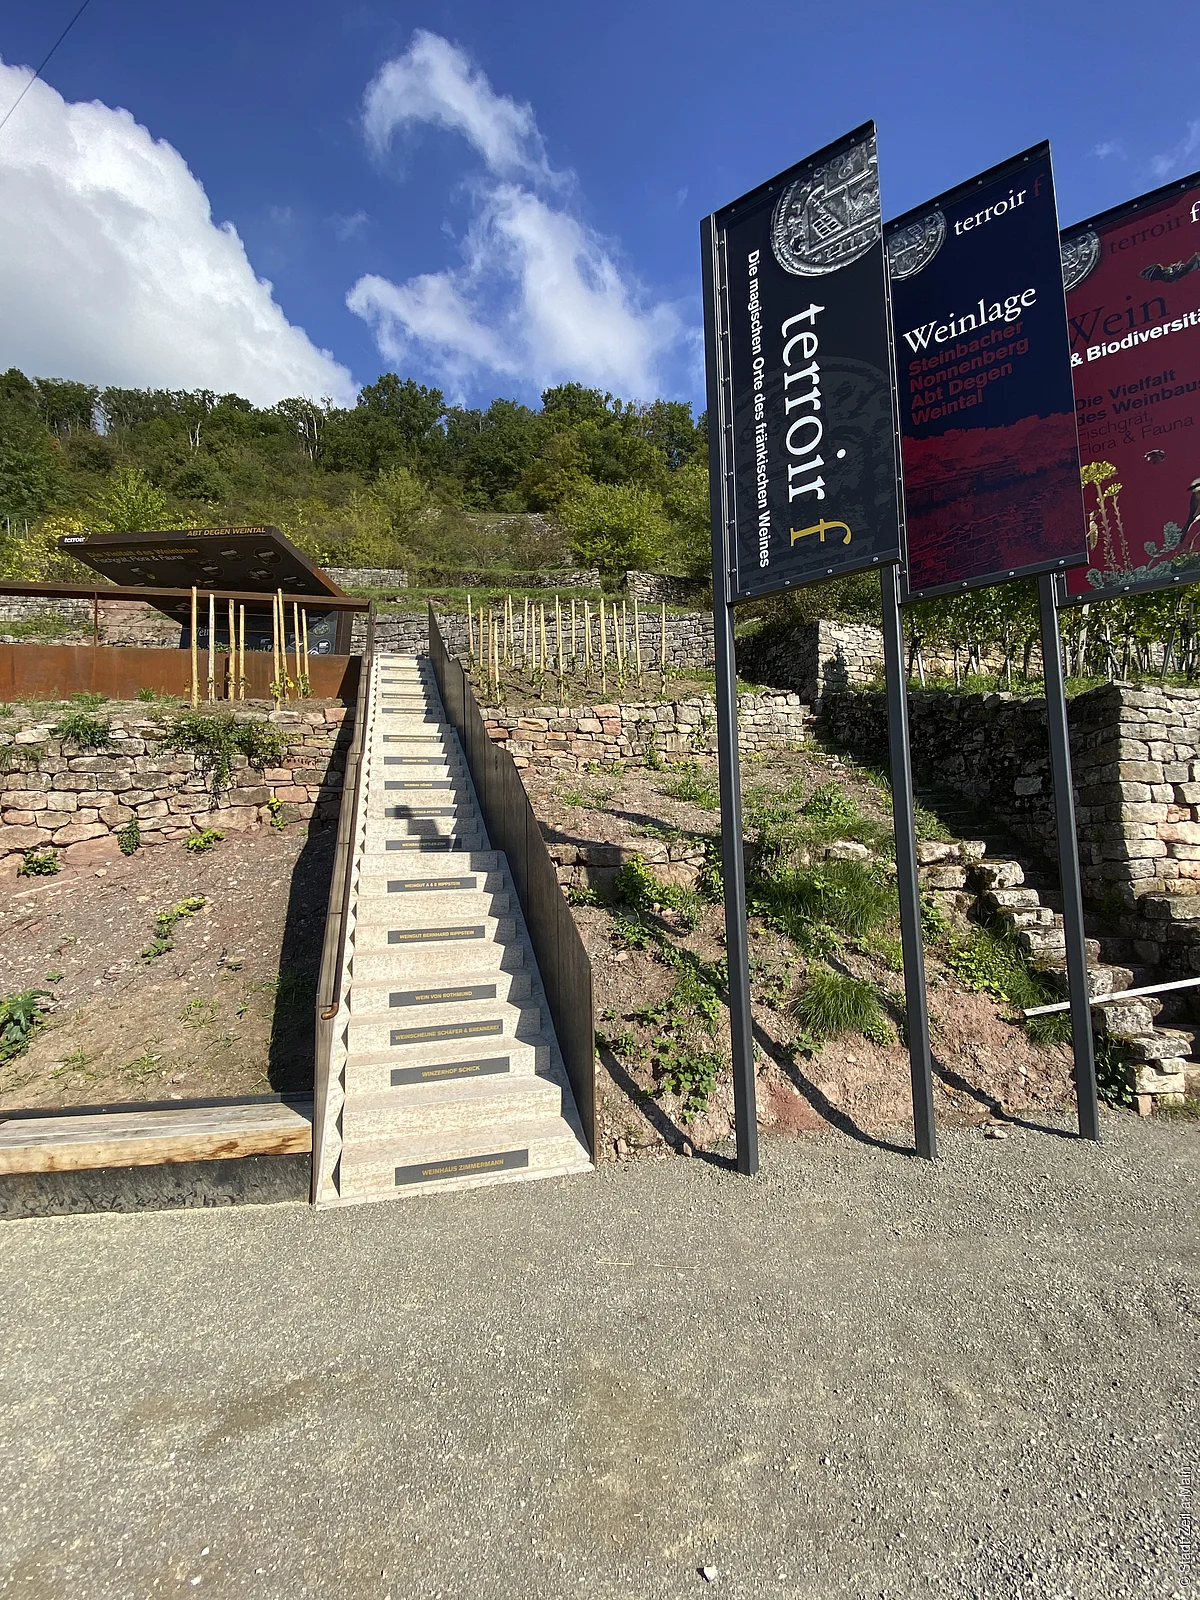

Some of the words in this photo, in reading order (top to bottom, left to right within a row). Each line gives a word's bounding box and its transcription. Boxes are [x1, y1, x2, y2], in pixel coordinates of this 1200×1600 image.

[953, 189, 1027, 236] terroir
[1033, 173, 1045, 198] f
[1109, 213, 1184, 255] terroir
[1190, 200, 1200, 223] f
[747, 249, 760, 277] Die
[747, 277, 764, 356] magischen
[902, 288, 1037, 354] Weinlage
[1069, 294, 1171, 350] Wein
[1071, 352, 1084, 368] &
[1087, 308, 1200, 362] Biodiversit
[908, 321, 1024, 376] Steinbacher
[910, 338, 1030, 393] Nonnenberg
[752, 356, 765, 391] Orte
[911, 386, 944, 410] Abt
[949, 362, 1013, 396] Degen
[1076, 394, 1103, 412] Die
[1108, 369, 1177, 399] Vielfalt
[754, 393, 767, 421] des
[781, 302, 847, 503] terroir
[911, 388, 984, 426] Weintal
[1077, 410, 1107, 427] des
[1112, 379, 1200, 414] Weinbau
[1078, 410, 1153, 439] Fischgrät,
[1080, 439, 1117, 456] Flora
[1123, 430, 1135, 444] &
[1142, 416, 1195, 440] Fauna
[755, 422, 770, 510] fränkischen
[63, 535, 85, 544] terroir
[186, 529, 203, 537] ABT
[203, 528, 231, 536] DEGEN
[232, 526, 266, 535] WEINTAL
[758, 510, 772, 568] Weines
[789, 517, 852, 547] f
[421, 1068, 457, 1077] WINZERHOF
[458, 1065, 480, 1073] SCHICK
[422, 1166, 457, 1176] WEINHAUS
[459, 1159, 504, 1170] ZIMMERMANN
